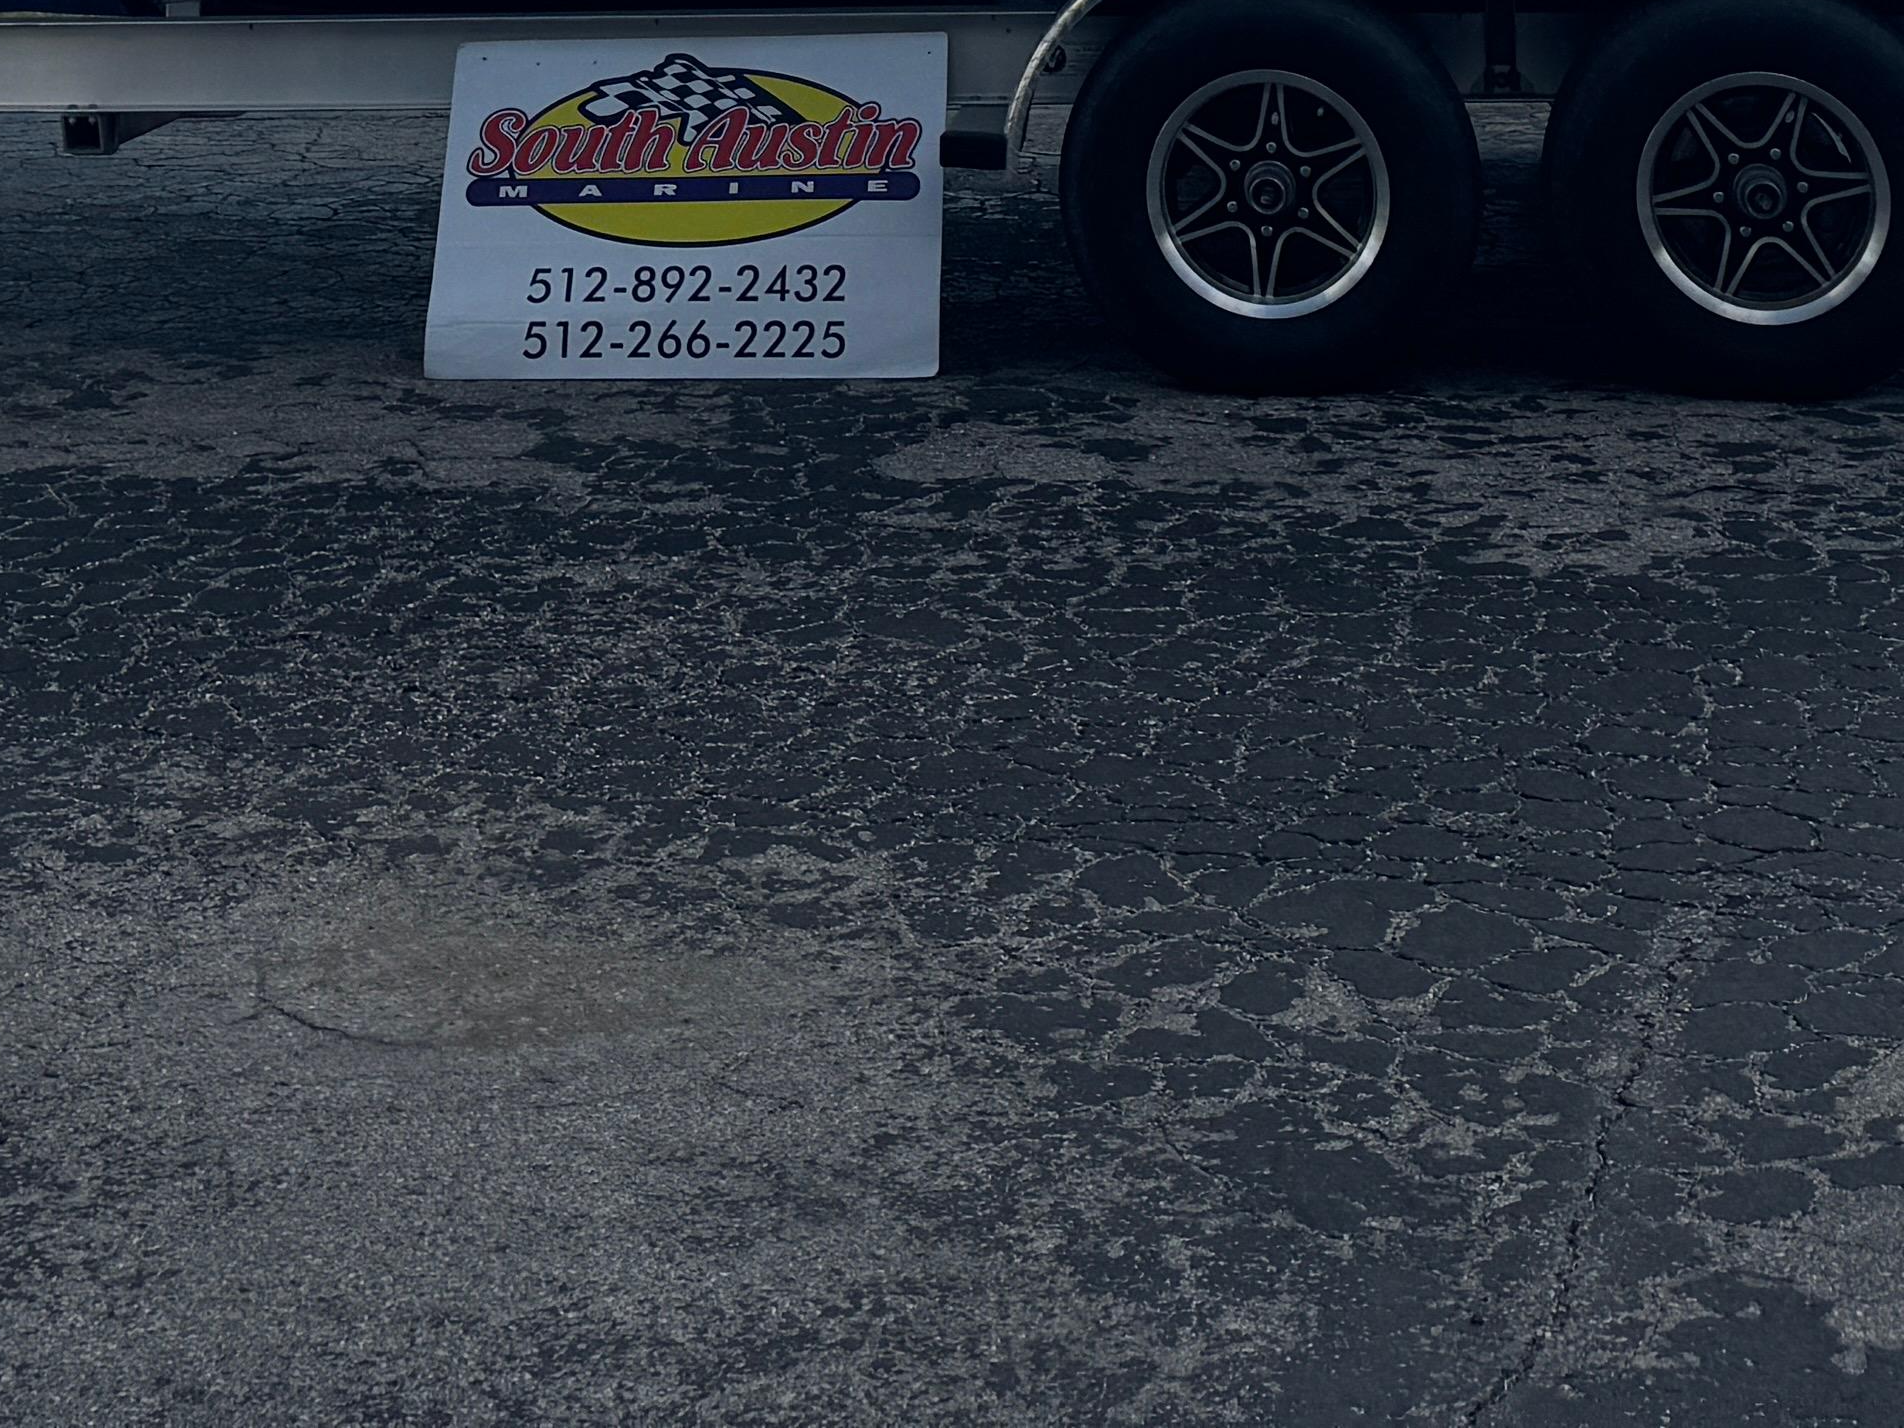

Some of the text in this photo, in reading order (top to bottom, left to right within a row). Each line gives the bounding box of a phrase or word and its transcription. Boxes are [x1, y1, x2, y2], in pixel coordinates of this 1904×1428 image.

[467, 101, 923, 177] South Austin
[499, 179, 889, 199] MARINE
[526, 264, 847, 305] 512-892-2432
[522, 319, 847, 360] 512-266-2225
